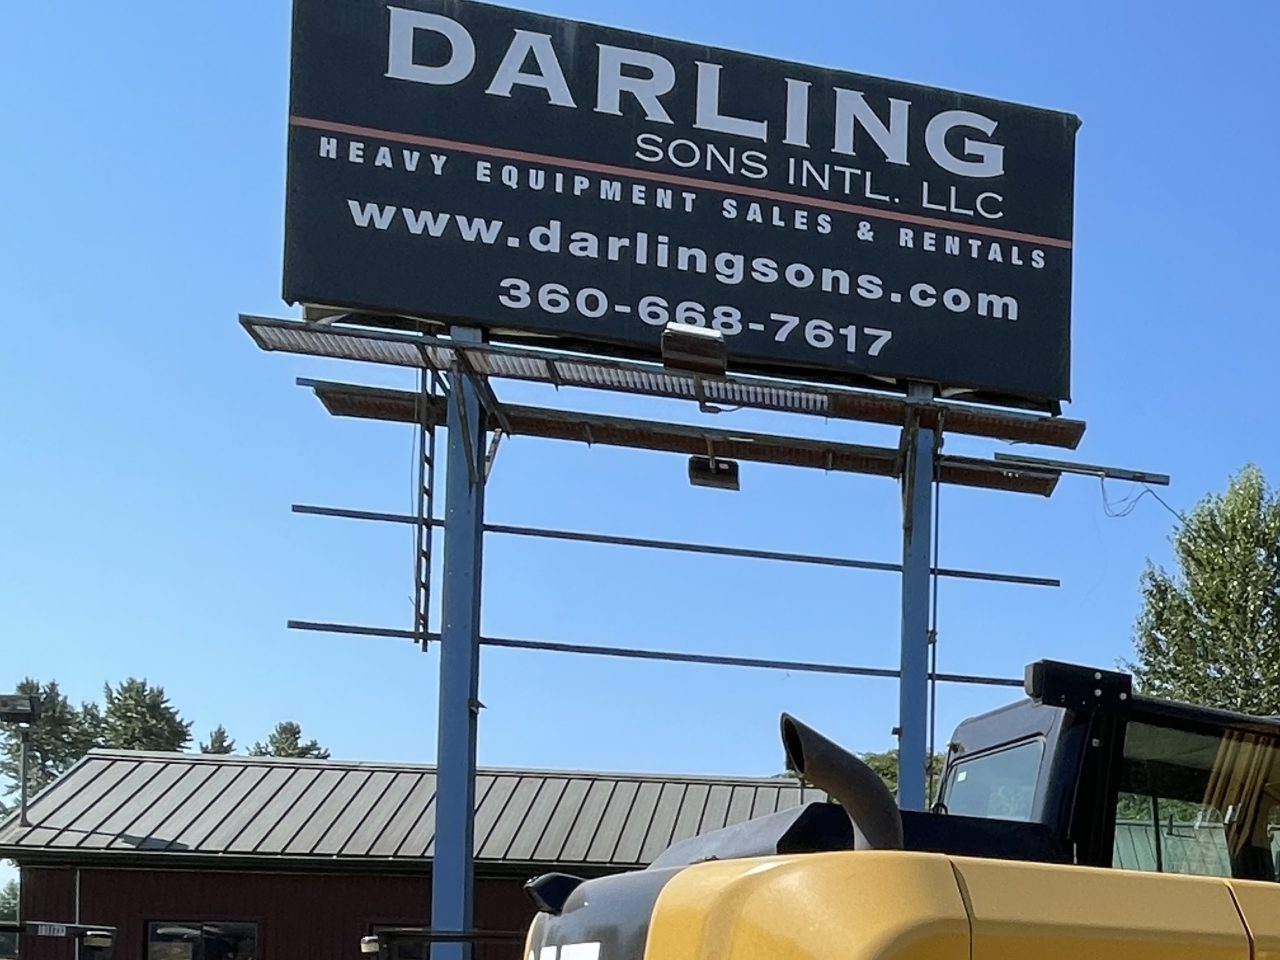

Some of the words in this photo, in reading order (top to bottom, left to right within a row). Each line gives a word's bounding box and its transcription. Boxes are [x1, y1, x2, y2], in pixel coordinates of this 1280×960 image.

[384, 5, 1005, 178] DARLING
[318, 136, 448, 176] HEAVY
[476, 160, 697, 213] EQUIPMENT
[722, 199, 833, 235] SALES
[857, 220, 875, 242] &
[899, 227, 1047, 270] RENTALS
[634, 132, 769, 180] SONS
[788, 156, 900, 204] INTL.
[921, 180, 1005, 220] LLC
[346, 199, 1020, 322] www.darlingsons.com
[498, 277, 893, 357] 360-668-7617
